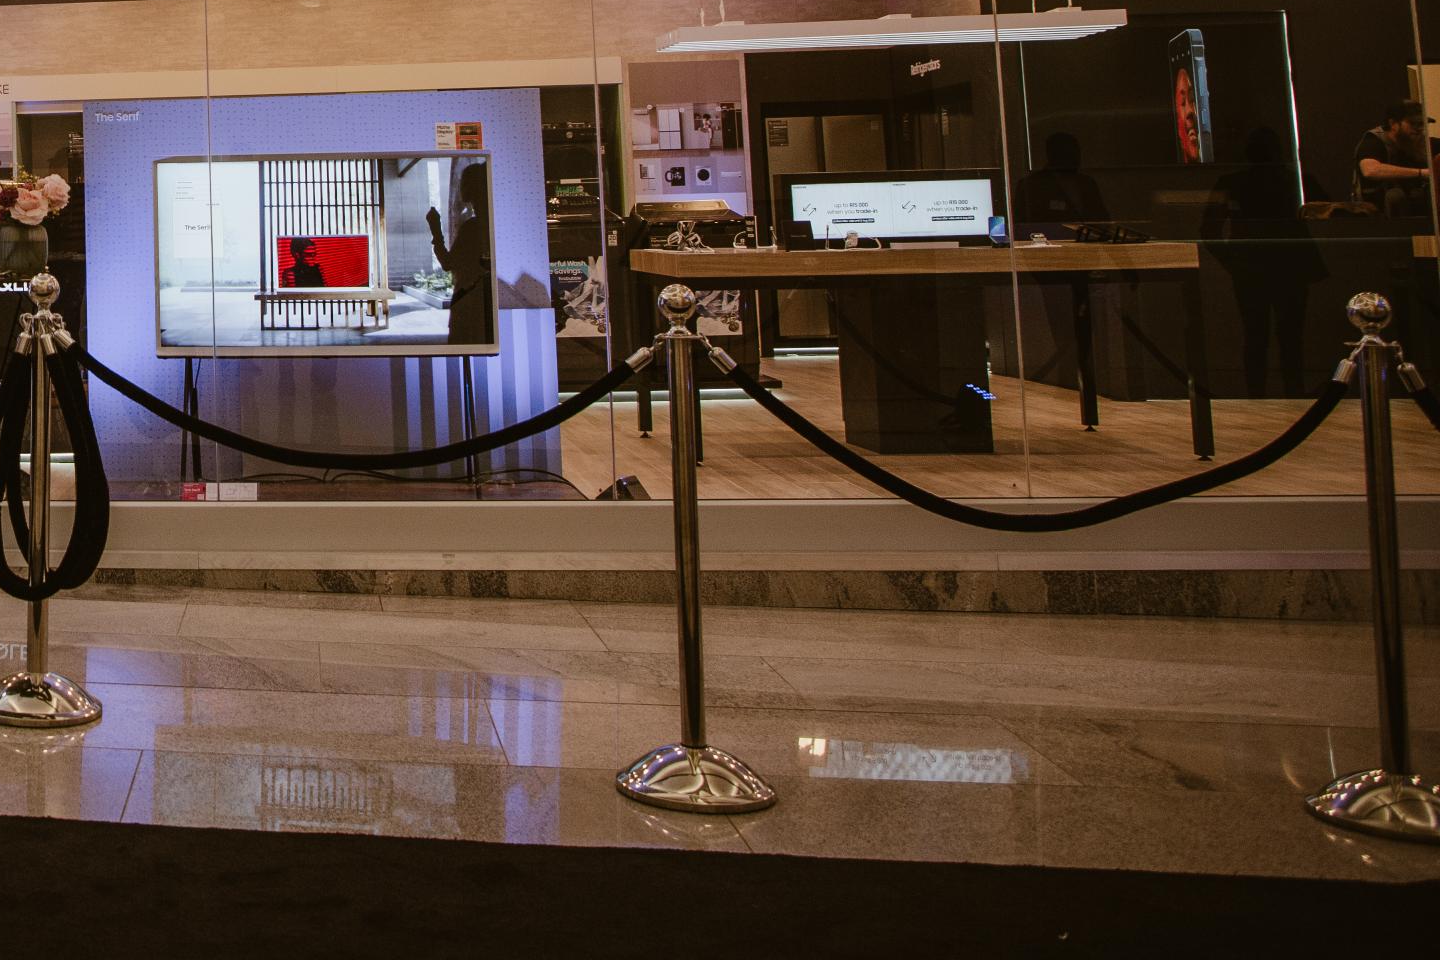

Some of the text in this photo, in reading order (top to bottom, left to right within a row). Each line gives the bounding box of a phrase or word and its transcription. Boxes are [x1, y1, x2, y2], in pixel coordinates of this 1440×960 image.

[95, 110, 140, 123] The Serif
[549, 260, 566, 269] erful
